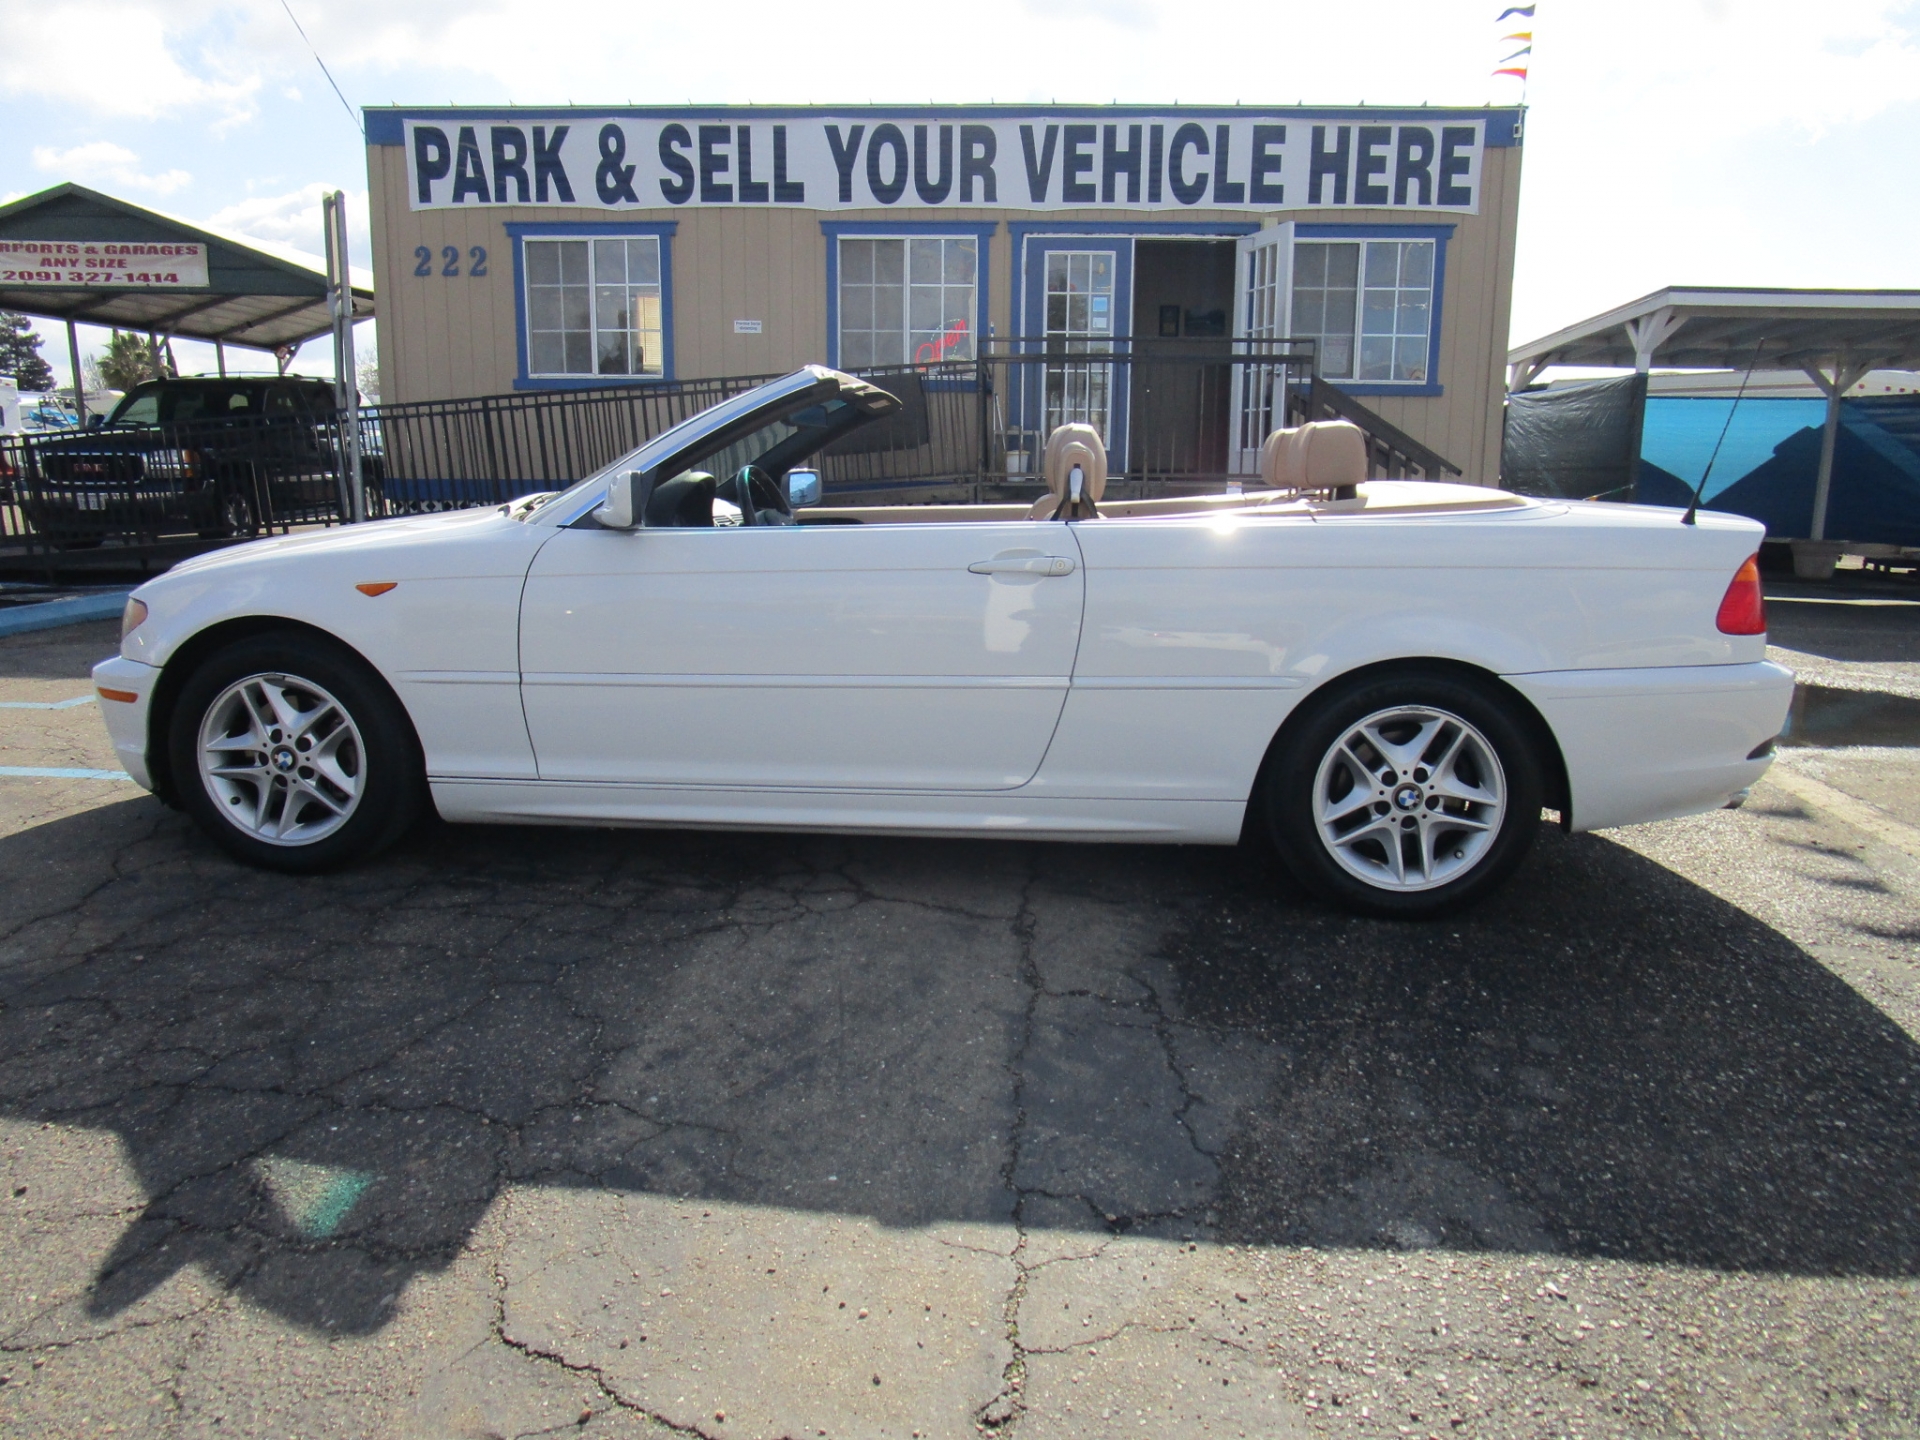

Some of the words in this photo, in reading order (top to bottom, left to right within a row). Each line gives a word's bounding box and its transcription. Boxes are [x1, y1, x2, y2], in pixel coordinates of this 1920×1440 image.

[413, 125, 576, 204] PARK
[595, 123, 639, 205] &
[659, 123, 805, 204] SELL
[823, 123, 998, 204] YOUR
[1019, 122, 1287, 205] VEHICLE
[1307, 125, 1477, 206] HERE
[0, 243, 79, 255] RPORTS
[84, 245, 99, 255] &
[104, 244, 199, 256] GARAGES
[39, 257, 80, 268] ANY
[85, 258, 128, 269] SIZE
[414, 245, 488, 277] 222
[0, 270, 62, 282] 209)
[68, 271, 179, 283] 327-1414
